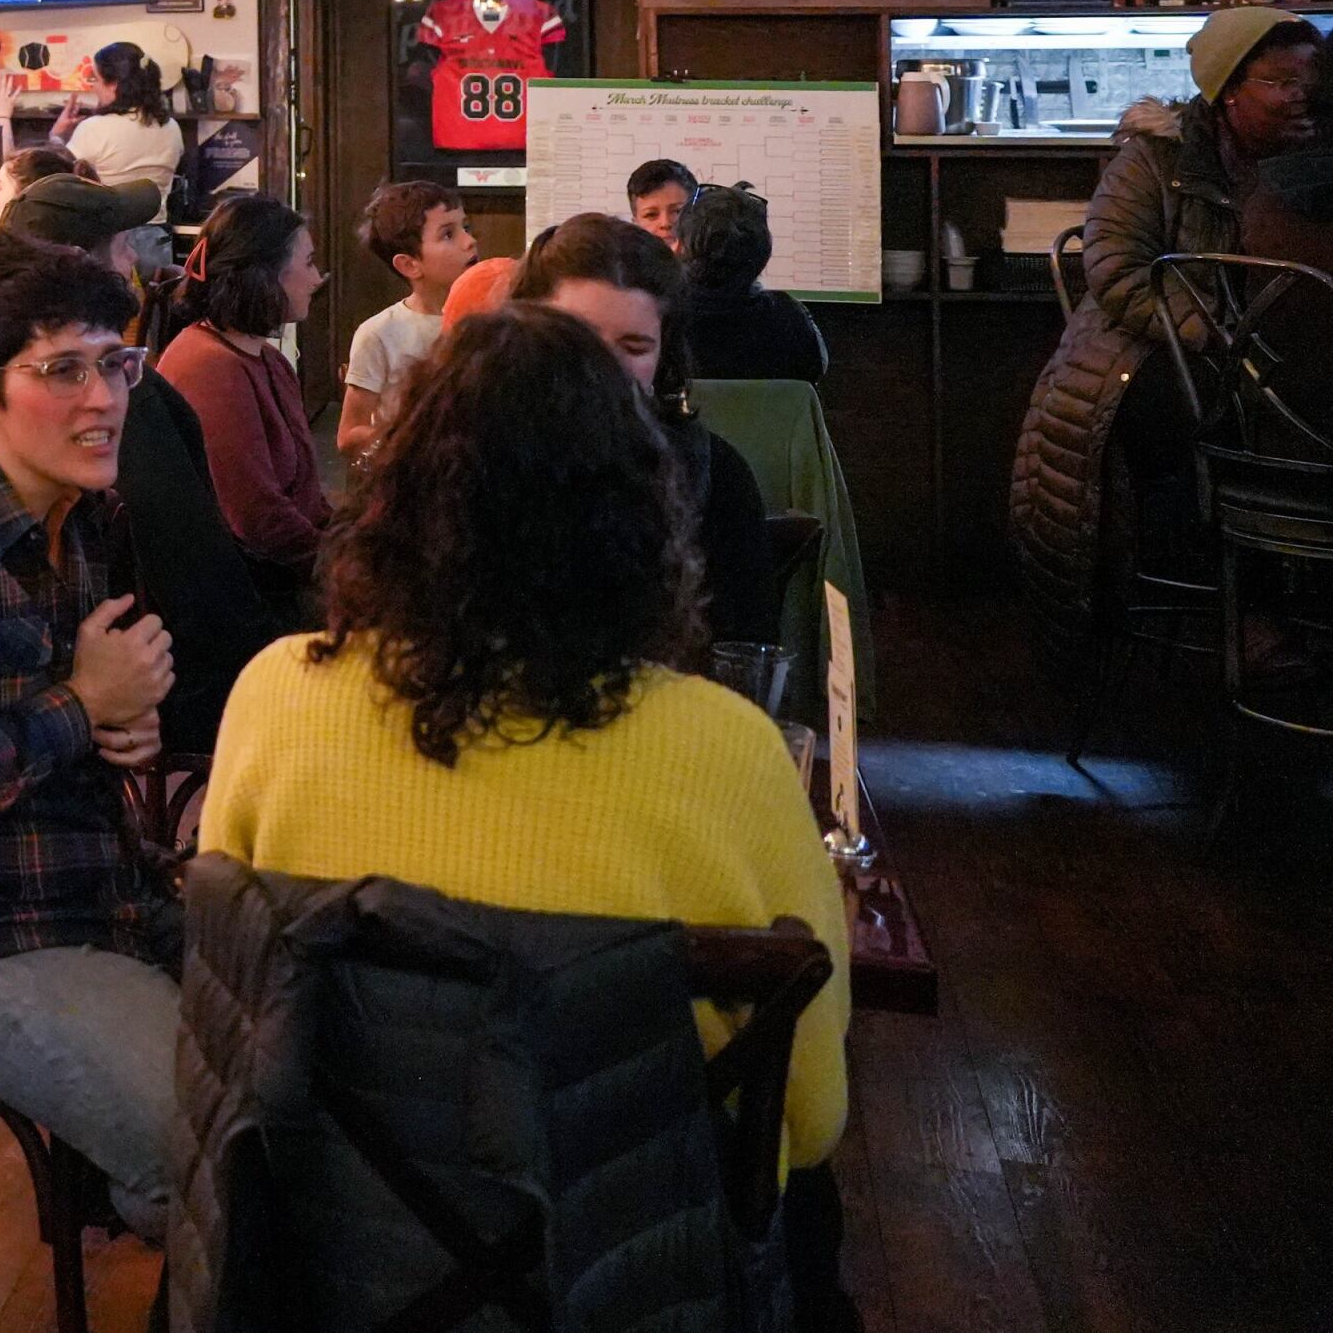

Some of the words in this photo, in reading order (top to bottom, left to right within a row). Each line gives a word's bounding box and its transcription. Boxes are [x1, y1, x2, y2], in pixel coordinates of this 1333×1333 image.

[460, 73, 524, 122] 88
[607, 92, 646, 105] March
[649, 94, 699, 105] Madness
[701, 96, 740, 106] bracket
[741, 96, 793, 109] challenge
